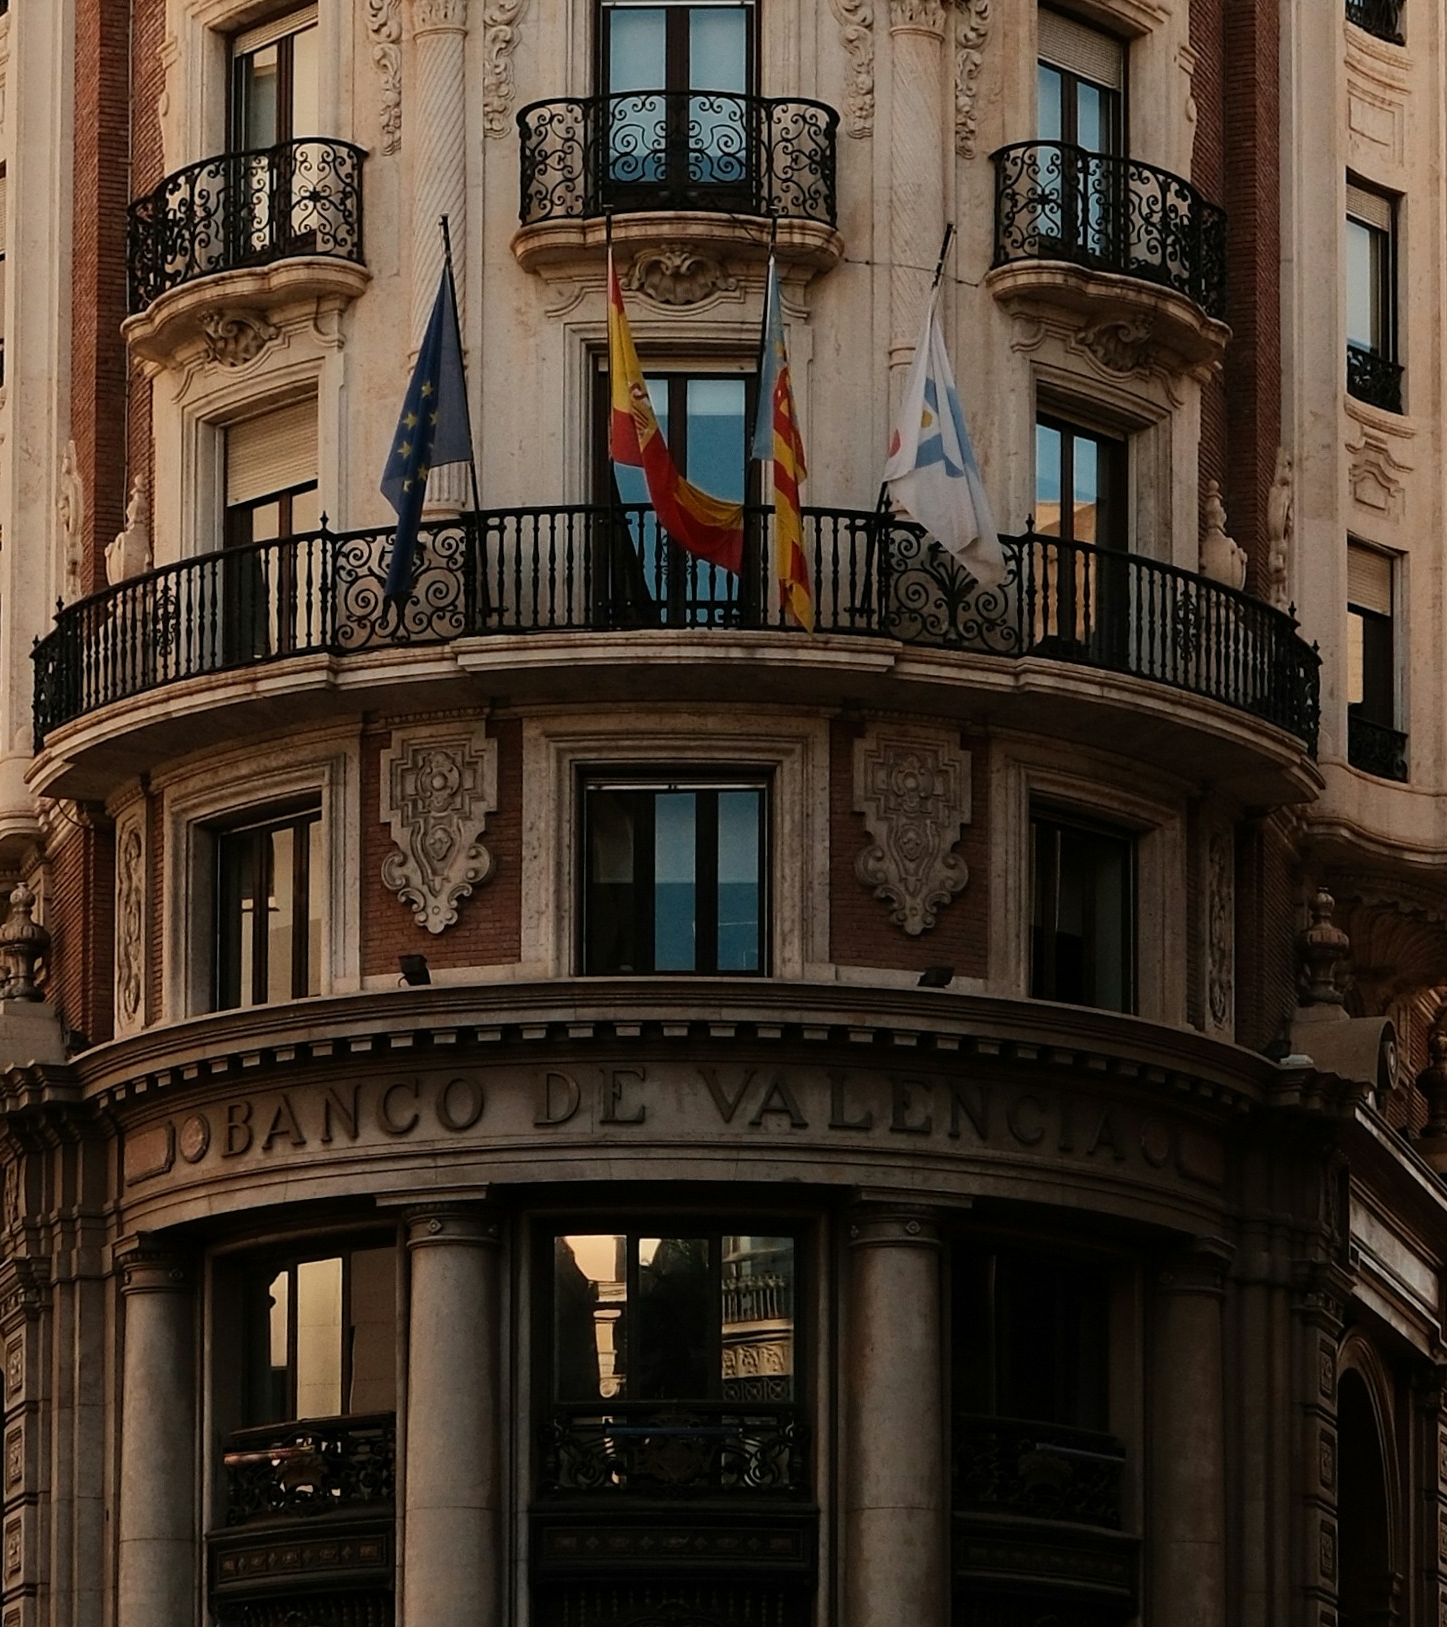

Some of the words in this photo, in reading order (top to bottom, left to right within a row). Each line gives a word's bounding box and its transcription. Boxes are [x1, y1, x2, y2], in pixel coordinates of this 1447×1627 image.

[221, 1075, 486, 1160] BANCO
[533, 1064, 648, 1128] DE
[695, 1064, 1128, 1162] VALENCIA
